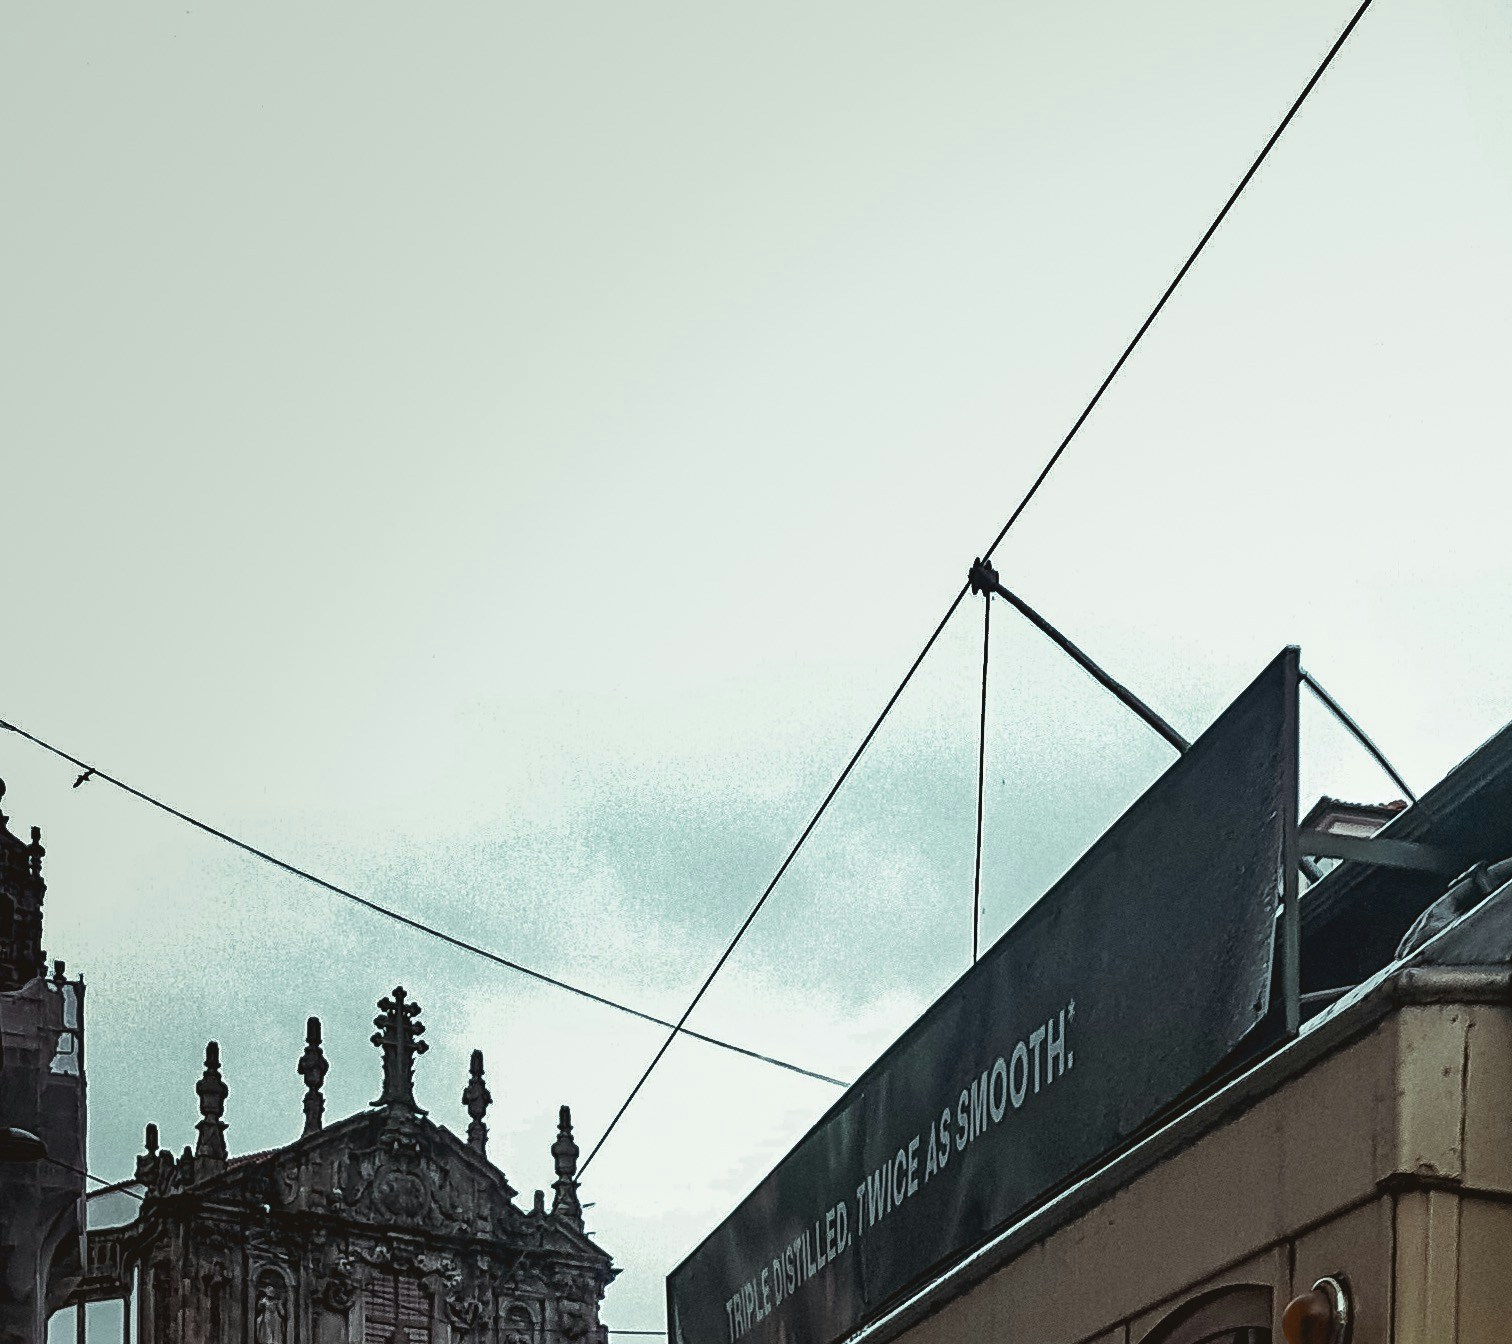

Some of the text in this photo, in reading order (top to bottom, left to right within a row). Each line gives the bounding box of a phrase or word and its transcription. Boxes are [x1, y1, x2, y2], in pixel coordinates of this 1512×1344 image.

[726, 1267, 771, 1343] TRIPLE
[857, 1135, 920, 1236] TWICE
[925, 1107, 950, 1183] AS
